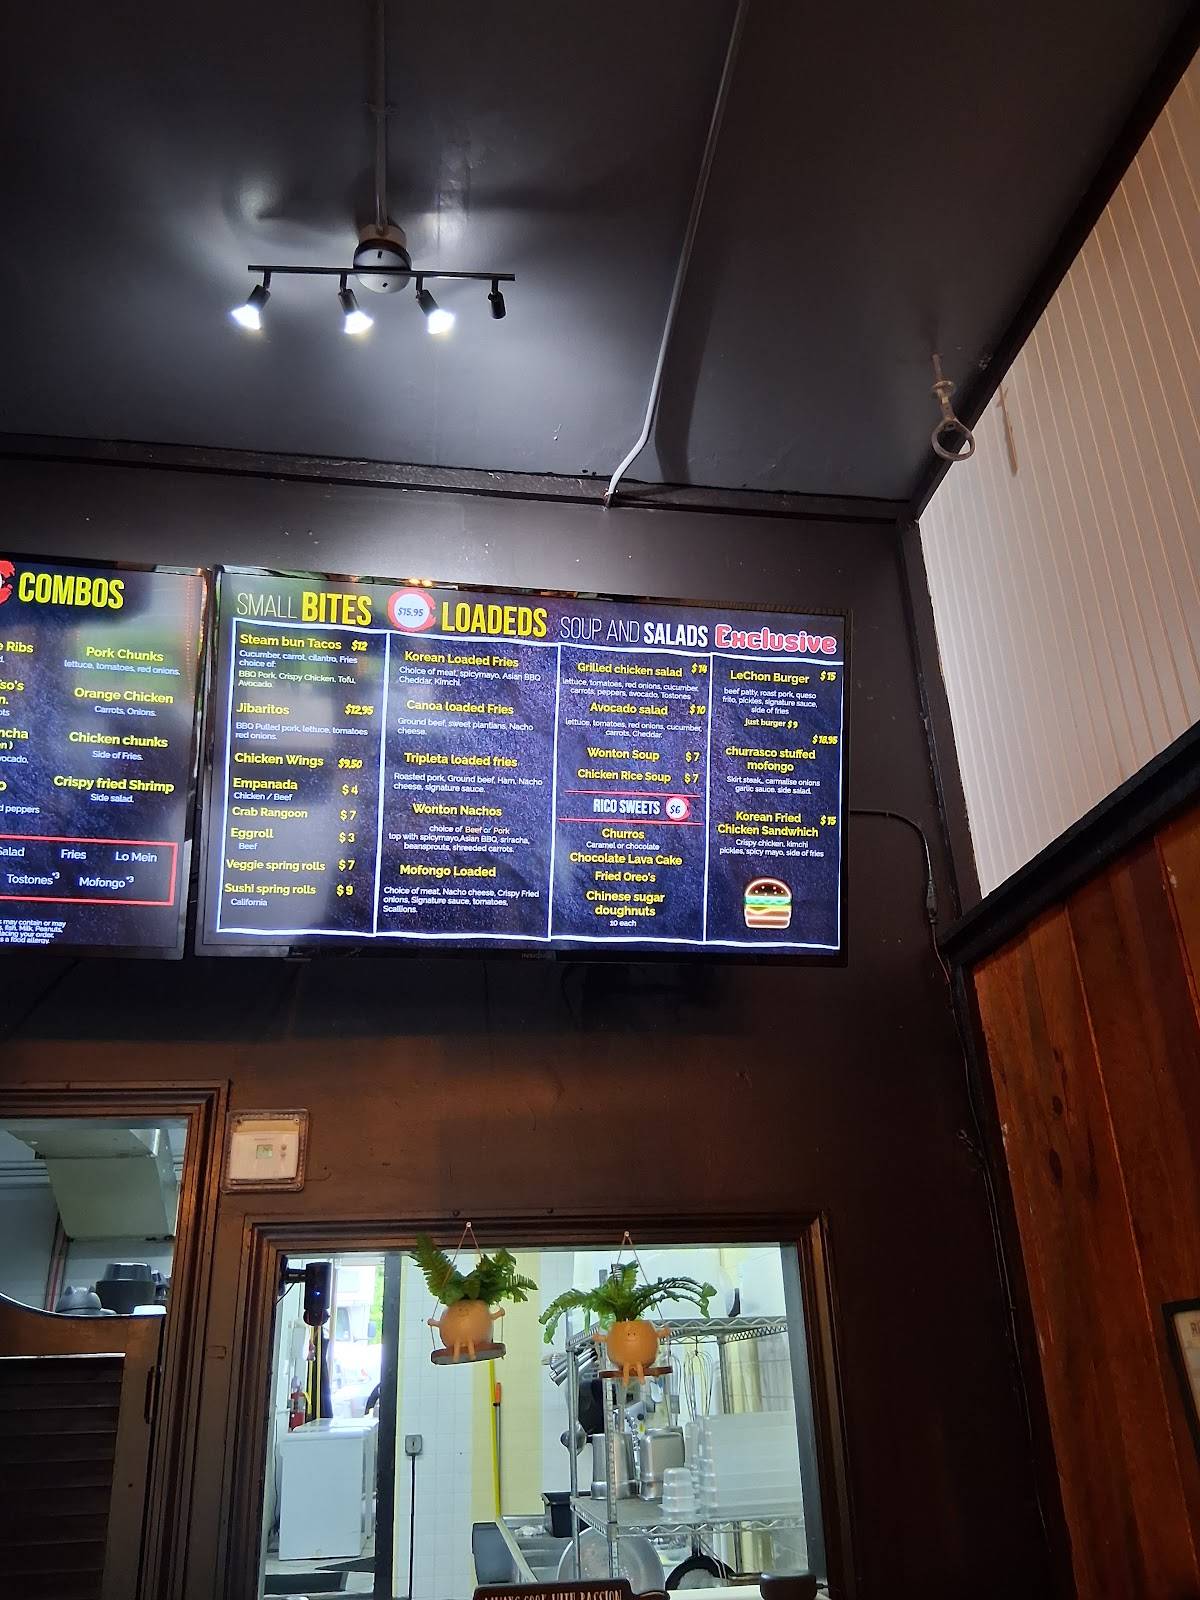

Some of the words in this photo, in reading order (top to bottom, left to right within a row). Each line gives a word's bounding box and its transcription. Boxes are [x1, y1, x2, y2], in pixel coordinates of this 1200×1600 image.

[19, 572, 124, 609] COMBOS
[236, 593, 297, 619] SMALL
[301, 591, 372, 626] BITES
[398, 608, 424, 617] $15.95
[441, 602, 547, 637] LOADEDS
[560, 617, 601, 640] SOUP
[607, 620, 640, 643] AND
[644, 623, 709, 647] SALADS
[240, 634, 279, 646] Steam
[281, 636, 304, 647] bun
[308, 638, 342, 649] Tacos
[352, 640, 368, 652] $12
[715, 624, 836, 654] Exclusive
[6, 641, 33, 653] Ribs
[86, 647, 114, 658] Pork
[117, 649, 164, 662] Chunks
[405, 651, 445, 663] Korean
[448, 654, 490, 665] Loaded
[493, 657, 519, 668] Fries
[399, 667, 426, 675] Choice
[577, 663, 612, 674] Grilled
[614, 665, 653, 675] chicken
[655, 666, 683, 677] salad
[279, 673, 302, 681] Crispy
[730, 670, 771, 681] LeChon
[773, 672, 810, 685] Burger
[74, 688, 120, 702] Orange
[124, 690, 174, 703] Chicken
[236, 702, 290, 715] Jibaritos
[407, 700, 442, 711] Canoa
[445, 702, 485, 713] loaded
[488, 703, 514, 715] Fries
[590, 702, 637, 713] Avocado
[639, 705, 668, 715] salad
[398, 717, 426, 725] Ground
[449, 720, 471, 728] sweet
[509, 722, 534, 731] Nacho
[761, 719, 786, 728] burger
[69, 732, 122, 745] Chicken
[123, 735, 168, 748] chunks
[587, 747, 629, 758] Wonton
[632, 750, 660, 762] Soup
[726, 746, 777, 758] churrasco
[779, 749, 816, 759] stuffed
[234, 753, 283, 764] Chicken
[286, 755, 324, 768] Wings
[404, 753, 448, 765] Tripleta
[451, 754, 490, 766] loaded
[493, 757, 518, 767] fries
[747, 761, 794, 773] mofongo
[394, 773, 425, 781] Roasted
[448, 775, 476, 783] Ground
[519, 778, 543, 786] Nacho
[577, 769, 619, 779] Chicken
[621, 771, 643, 780] Rice
[645, 772, 671, 784] Soup
[54, 776, 95, 791] Crispy
[97, 779, 127, 790] fried
[129, 780, 174, 794] Shrimp
[233, 778, 297, 791] Empanada
[425, 784, 460, 792] signature
[234, 792, 265, 800] Chicken
[6, 805, 40, 814] peppers
[232, 807, 258, 816] Crab
[261, 808, 308, 819] Rangoon
[413, 803, 457, 815] Wonton
[460, 805, 503, 816] Nachos
[593, 799, 617, 813] RICO
[620, 800, 660, 814] SWEETS
[736, 811, 772, 822] Korean
[775, 813, 801, 823] Fried
[231, 828, 274, 840] Eggroll
[429, 825, 453, 833] choice
[602, 828, 645, 839] Churros
[718, 824, 759, 834] Chicken
[762, 826, 818, 837] Sandwhich
[389, 833, 401, 841] top
[586, 841, 616, 849] Caramel
[626, 843, 660, 851] chocolate
[61, 849, 86, 859] Fries
[116, 851, 129, 861] Lo
[131, 852, 157, 862] Mein
[569, 852, 626, 864] Chocolate
[628, 854, 653, 865] Lava
[655, 855, 683, 865] Cake
[226, 860, 264, 870] Veggie
[266, 862, 301, 872] spring
[302, 862, 326, 871] rolls
[400, 865, 451, 878] Mofongo
[453, 866, 496, 877] Loaded
[7, 874, 53, 885] Tostones
[595, 871, 621, 881] Fried
[623, 872, 656, 882] Oreo's
[79, 877, 125, 890] Mofongo
[225, 884, 255, 893] Sushi
[257, 885, 291, 896] spring
[293, 886, 317, 894] rolls
[411, 887, 419, 895] of
[443, 888, 466, 896] Nacho
[498, 890, 520, 898] Crispy
[521, 890, 539, 898] Fried
[586, 891, 631, 902] Chinese
[633, 893, 665, 904] sugar
[411, 896, 446, 905] Signature
[595, 905, 656, 917] doughnuts
